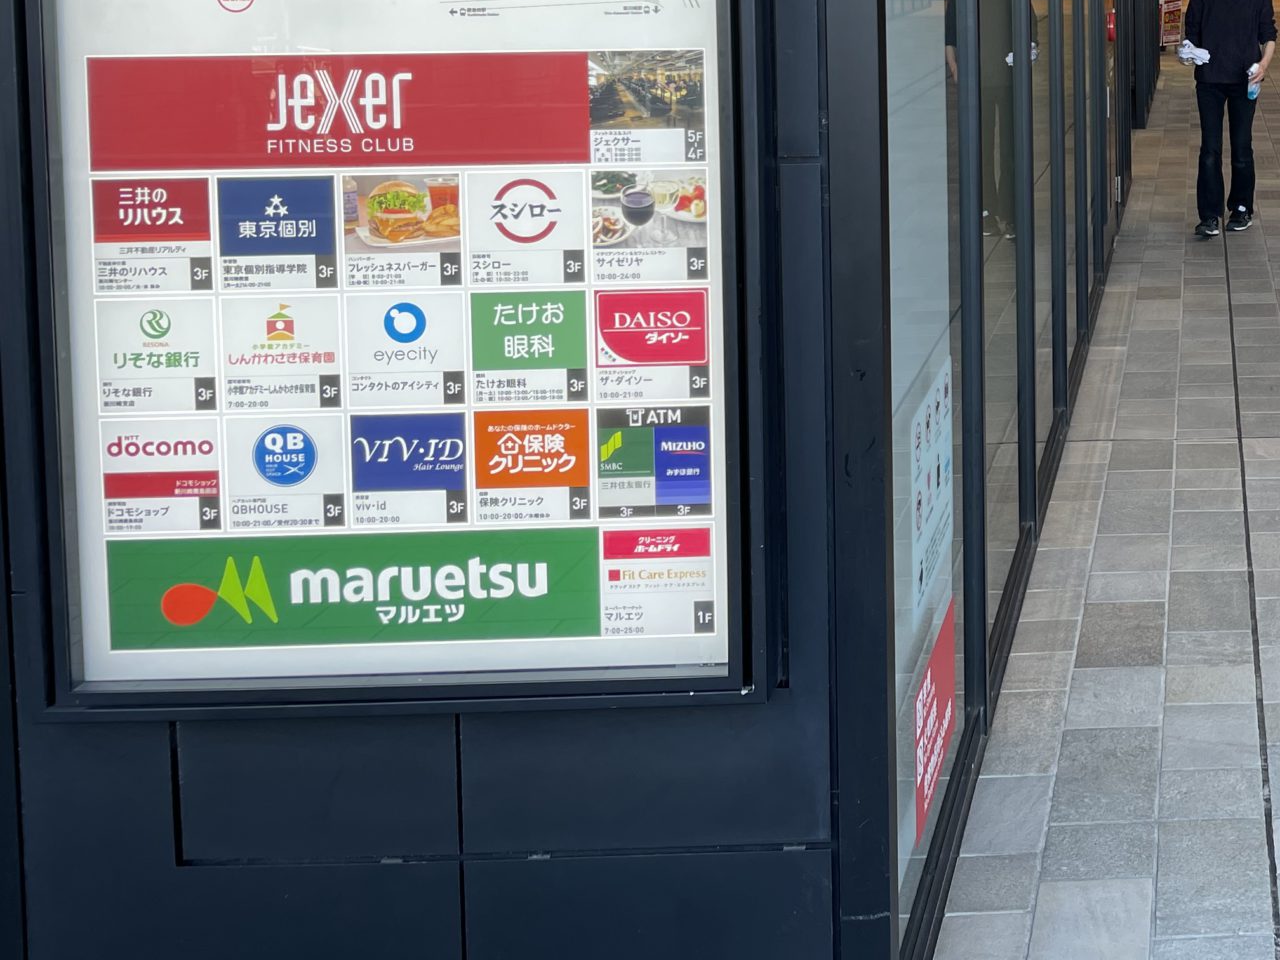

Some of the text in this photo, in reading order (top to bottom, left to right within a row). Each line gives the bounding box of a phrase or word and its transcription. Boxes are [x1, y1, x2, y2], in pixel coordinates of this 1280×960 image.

[593, 137, 641, 147] ジェクサー
[687, 130, 704, 143] 5F
[267, 137, 414, 153] FITNESS CLUB
[687, 148, 704, 160] 4F
[118, 187, 168, 205] 三井の
[118, 207, 184, 226] リハウス
[490, 201, 562, 221] スシロー
[238, 219, 317, 239] 東京個別
[348, 262, 437, 273] フレッシュネスバーガー
[472, 260, 511, 271] スシロー
[566, 260, 582, 273] 3F
[596, 256, 644, 268] サイゼリヤ
[690, 257, 705, 271] 3F
[98, 266, 168, 277] 三井のリハウス
[193, 267, 209, 280] 3F
[223, 264, 308, 275] 東京個別指導学院
[318, 265, 335, 278] 3F
[443, 262, 459, 276] 3F
[492, 302, 565, 326] たけお
[613, 311, 691, 329] DAISO
[645, 331, 690, 345] ダイソー
[504, 333, 555, 359] 眼科
[112, 351, 200, 369] りそな銀行
[228, 351, 336, 366] しんかわさき保育園
[373, 346, 438, 366] eyecity
[351, 380, 440, 392] コンタクトのアイシティ
[475, 378, 527, 389] たけお眼科
[570, 378, 585, 392] 3F
[600, 375, 653, 386] ザ・ダイソー
[692, 376, 707, 389] 3F
[102, 387, 153, 398] りそな銀行
[198, 388, 214, 401] 3F
[322, 385, 338, 399] 3F
[446, 381, 462, 395] 3F
[228, 400, 269, 408] 7:00-20:00
[646, 409, 682, 424] ATM
[487, 423, 576, 432] あなたの保険のホームドクター
[106, 436, 214, 458] docomo
[264, 432, 305, 453] QB
[524, 434, 566, 454] 保険
[265, 453, 305, 463] HOUSE
[488, 453, 577, 474] クリニック
[413, 463, 464, 472] Hair Lounge
[600, 462, 623, 471] SMBC
[175, 479, 217, 488] ドコモショップ
[601, 480, 651, 490] 三井住友銀行
[449, 501, 465, 514] 3F
[478, 496, 545, 508] 保険クリニック
[572, 497, 588, 510] 3F
[107, 505, 170, 518] ドコモショップ
[202, 507, 218, 521] 3F
[231, 503, 289, 515] QBHOUSE
[326, 504, 342, 517] 3F
[620, 507, 634, 517] 3F
[677, 505, 691, 516] 3F
[355, 515, 400, 523] 10:00-20:00
[638, 535, 677, 544] クリーニング
[633, 543, 681, 553] ホームドライ
[290, 556, 549, 604] maruetsu
[622, 568, 707, 581] Fit Care Express
[375, 604, 465, 625] マルエツ
[604, 611, 644, 621] マルエツ
[697, 611, 712, 624] 1F
[604, 626, 645, 634] 7:00-25:00
